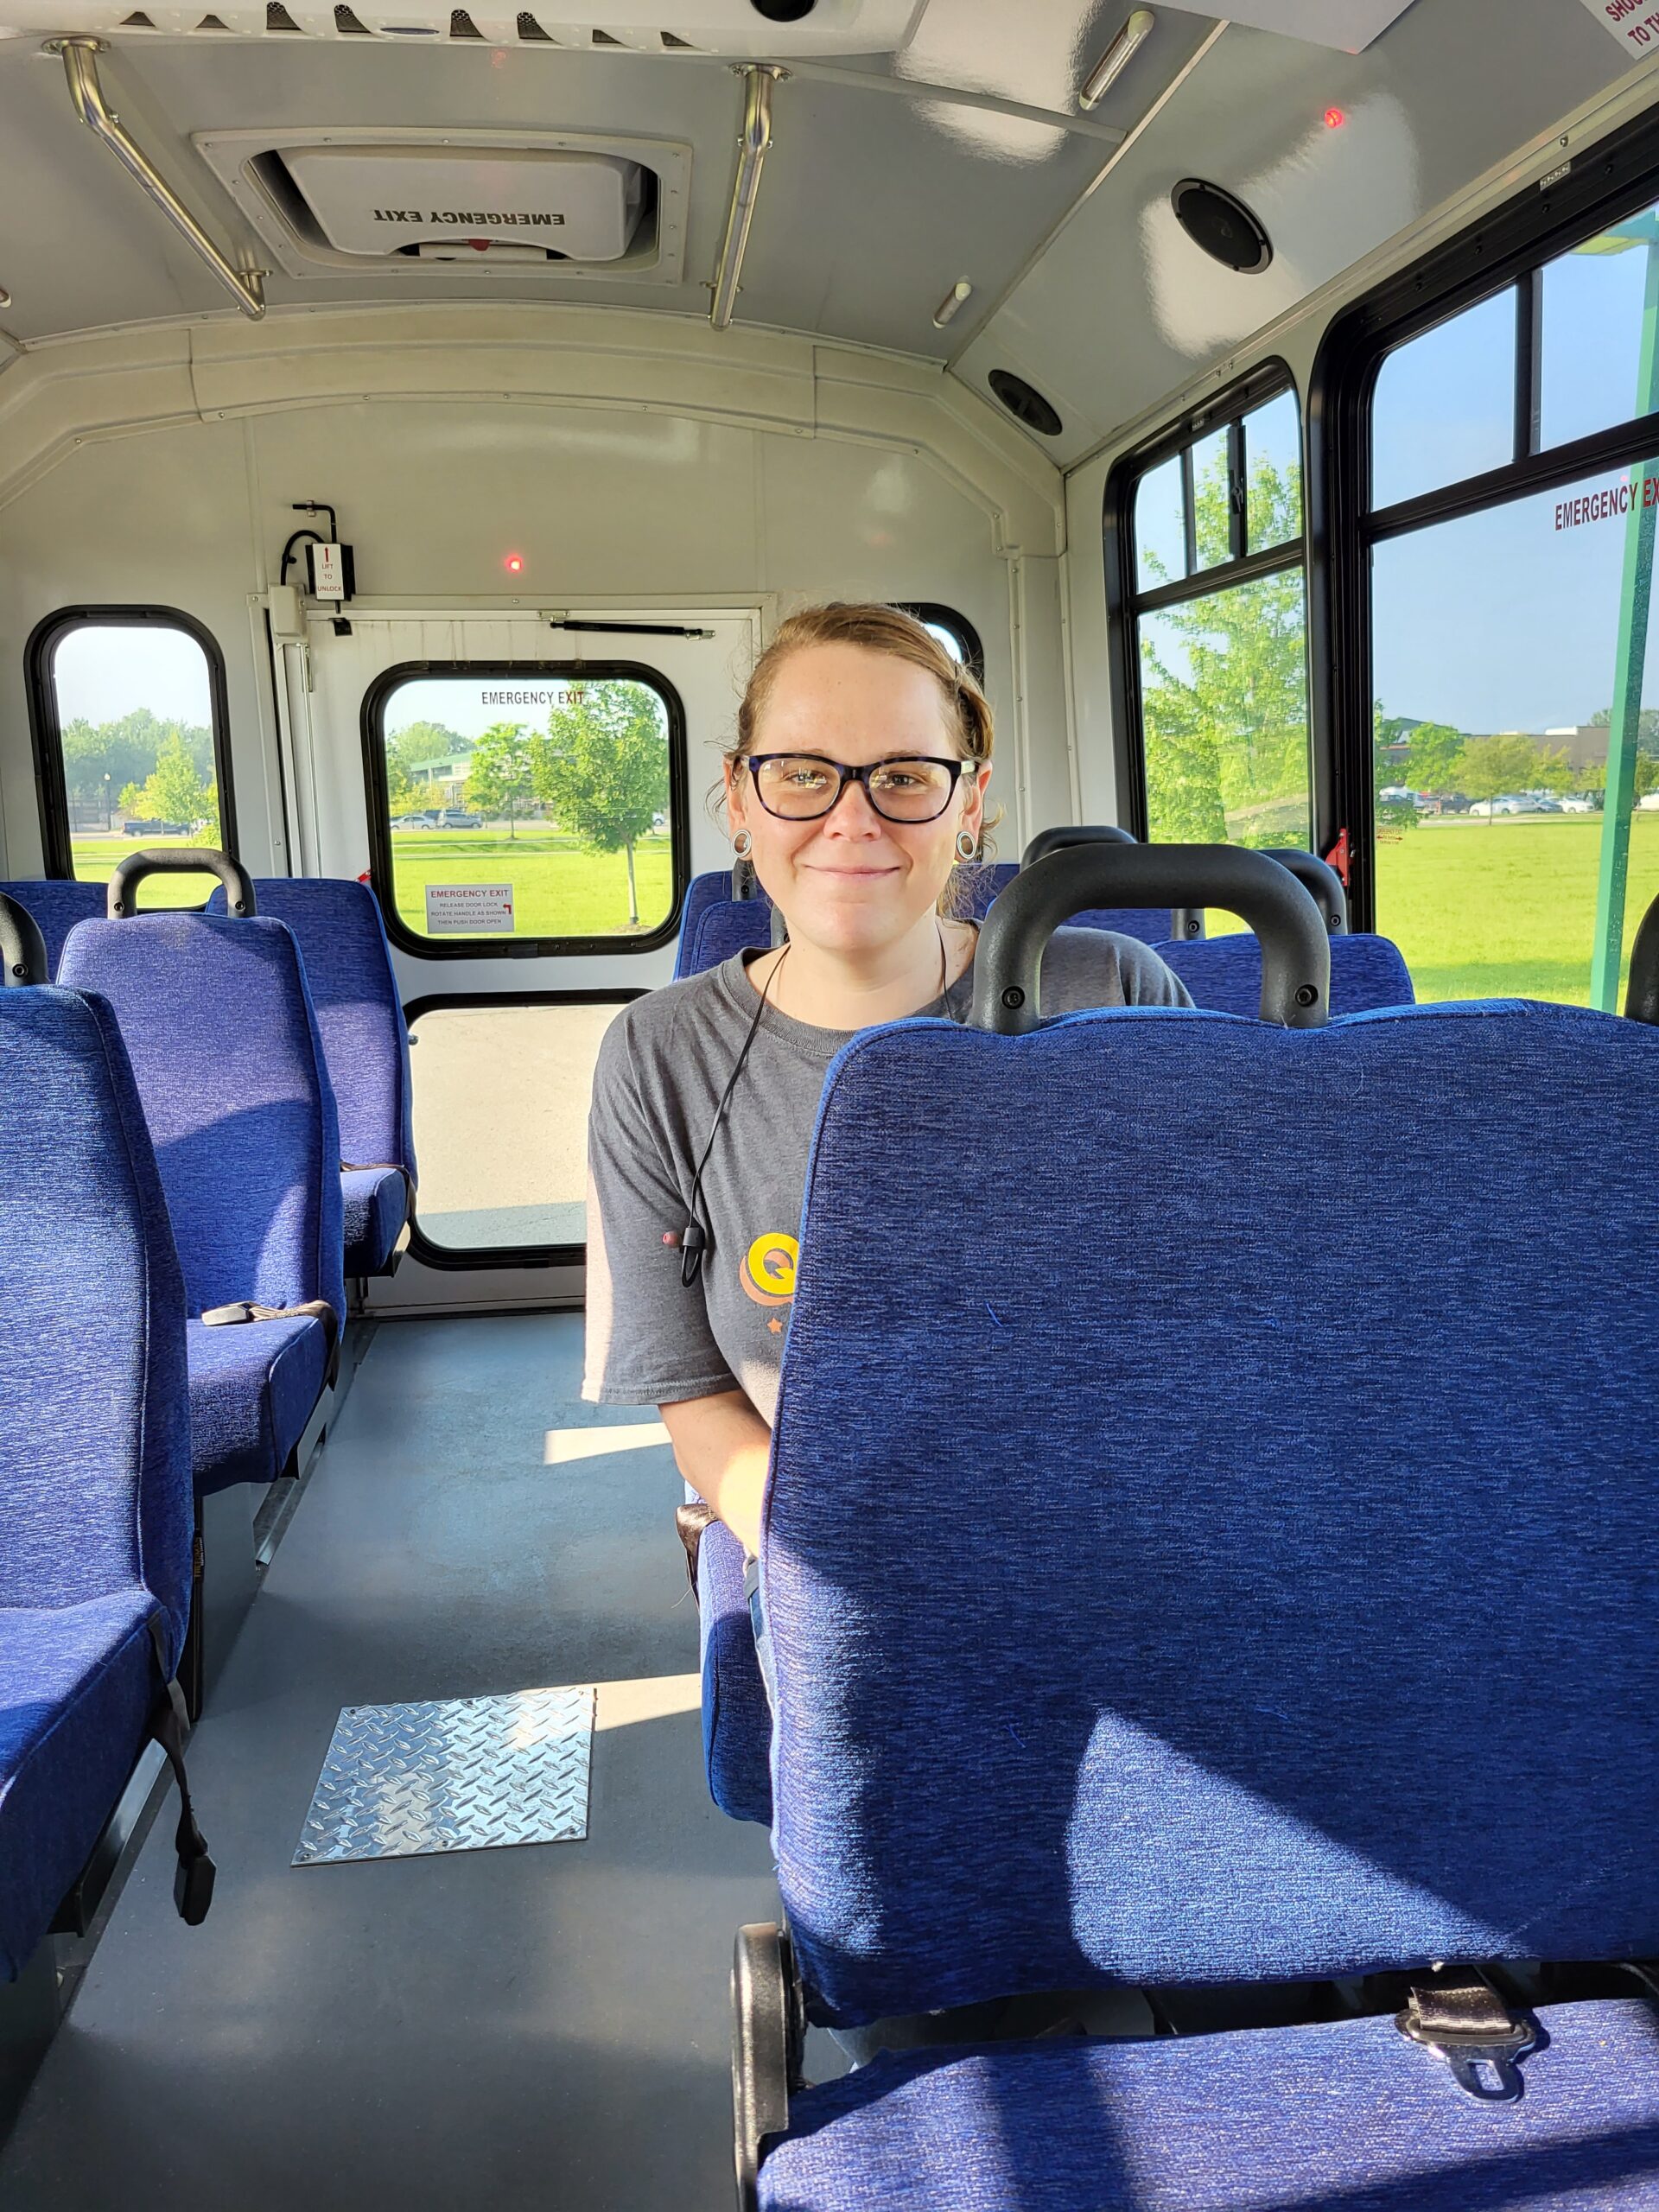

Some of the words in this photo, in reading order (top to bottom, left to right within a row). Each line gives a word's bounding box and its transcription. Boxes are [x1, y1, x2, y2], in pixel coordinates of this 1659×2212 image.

[1605, 0, 1643, 22] SHO
[1627, 26, 1650, 46] TO
[373, 209, 423, 222] EXIT
[430, 212, 565, 226] EMERGENCY
[1555, 482, 1638, 531] EMERGENCY
[482, 691, 554, 704] EMERGENCY
[558, 691, 584, 704] EXIT
